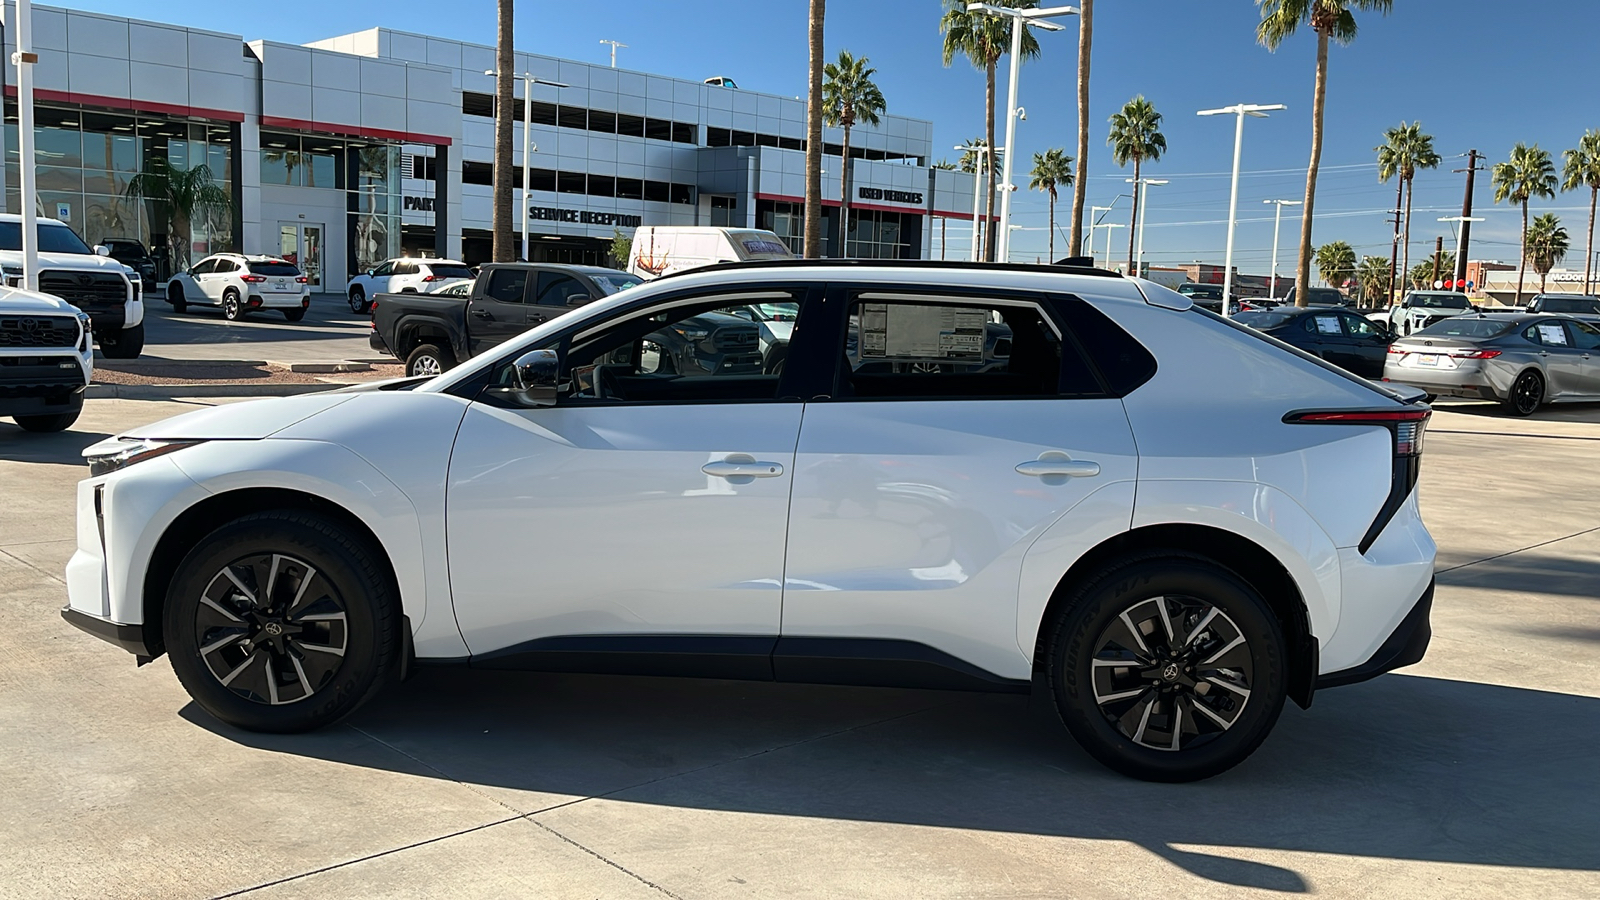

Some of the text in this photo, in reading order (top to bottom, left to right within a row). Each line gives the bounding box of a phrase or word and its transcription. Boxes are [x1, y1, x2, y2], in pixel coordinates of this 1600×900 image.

[859, 187, 923, 204] USED VEHICLES
[529, 206, 642, 228] SERVICE RECEPTION
[1066, 601, 1102, 699] COUNTRY
